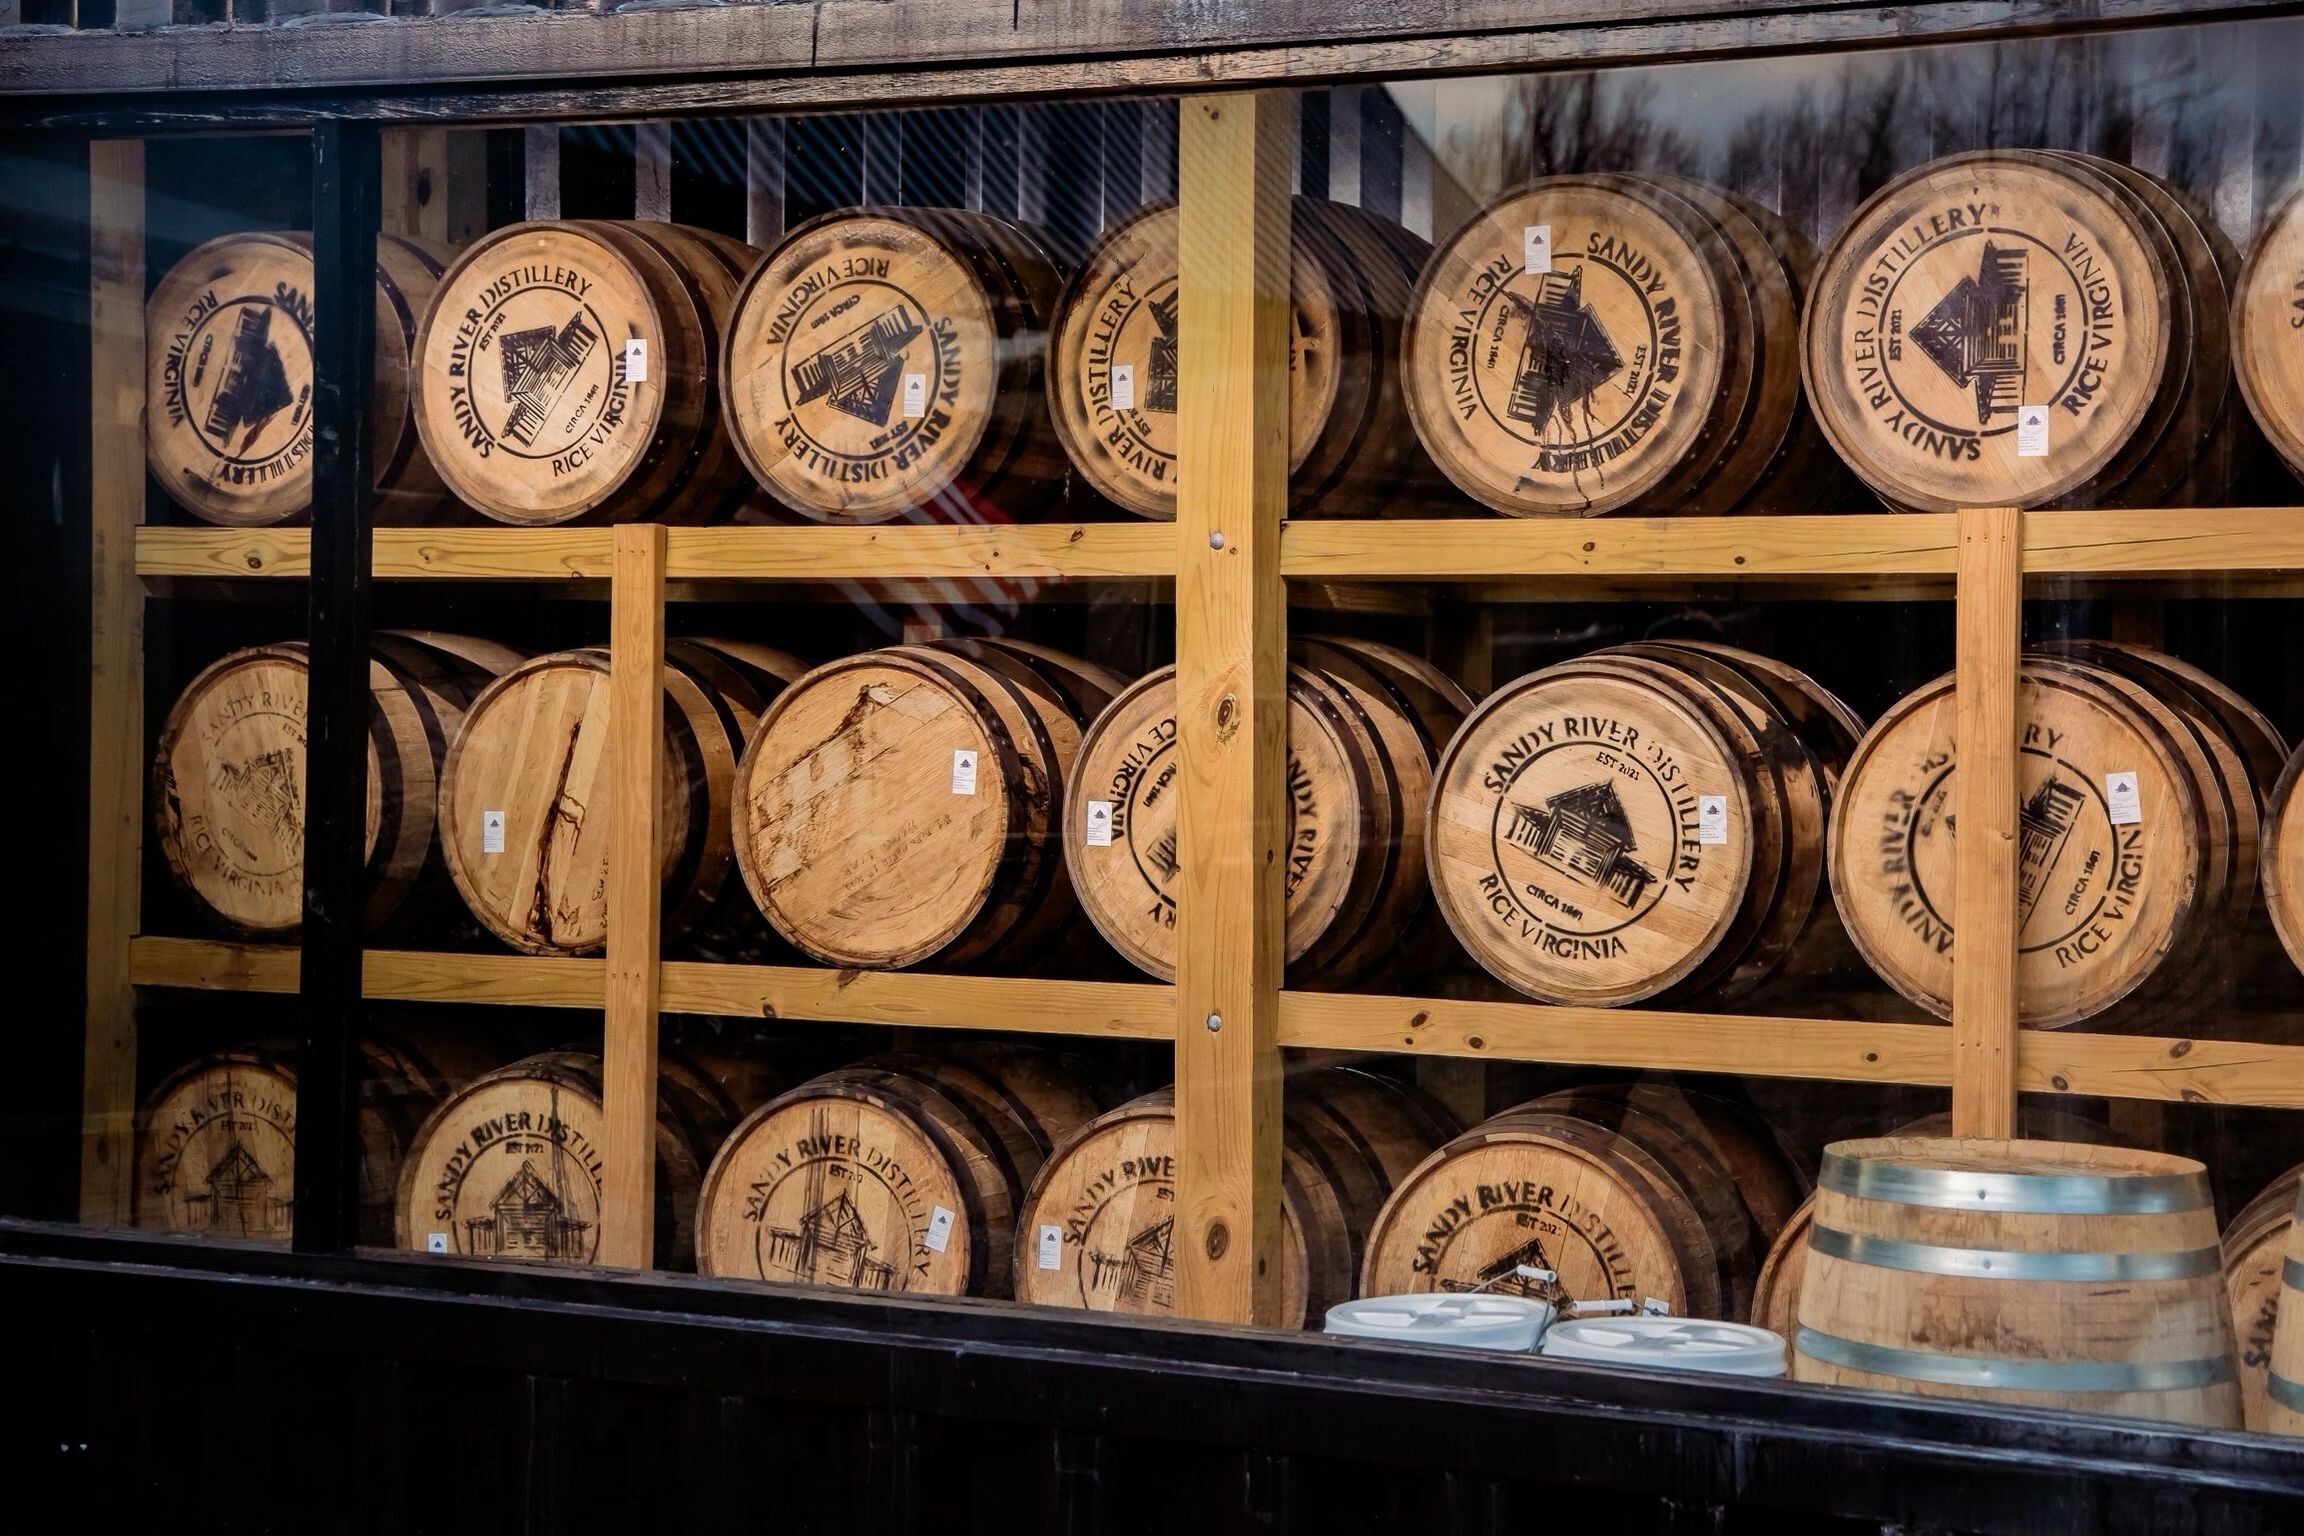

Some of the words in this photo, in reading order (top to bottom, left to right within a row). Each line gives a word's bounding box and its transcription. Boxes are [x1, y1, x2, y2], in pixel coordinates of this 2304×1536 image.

[478, 264, 593, 309] DISTILLERY
[843, 257, 890, 279] RICE
[1466, 253, 1513, 305] RICE
[1856, 202, 1987, 319] DISTILLERY
[2062, 232, 2114, 351] VIRGINIA
[180, 289, 219, 330] RICE
[767, 265, 841, 346] VIRGINIA
[1492, 304, 1511, 343] CIRCA
[1587, 231, 1665, 296] SANDY
[1654, 297, 1681, 383] RIVER
[449, 307, 483, 377] RIVER
[479, 332, 494, 352] EST
[934, 316, 960, 408] SANDY
[1088, 280, 1139, 426] DISTILLERY
[1449, 306, 1479, 421] VIRGINIA
[1633, 345, 1647, 370] EST
[1854, 329, 1893, 411] RIVER
[1888, 337, 1902, 361] EST
[2052, 322, 2066, 366] CIRCA
[164, 332, 186, 428] VIRGINIA
[2061, 356, 2109, 416] RICE
[450, 385, 495, 458] SANDY
[565, 404, 588, 434] CIRCA
[774, 417, 889, 484] DISTILLERY
[892, 409, 953, 472] RIVER
[1134, 418, 1152, 438] EST
[1884, 410, 1981, 462] SANDY
[552, 442, 594, 477] RICE
[1107, 423, 1167, 481] RIVER
[262, 690, 308, 719] RIVE
[1148, 717, 1176, 746] CE
[1484, 722, 1554, 795] SANDY
[1564, 716, 1639, 751] RIVER
[1596, 751, 1618, 769] EST
[1107, 742, 1153, 842] VIRGINIA
[1479, 873, 1520, 927] RICE
[1521, 918, 1628, 961] VIRGINIA
[1526, 884, 1560, 910] CIRCA
[1891, 880, 1954, 962] ANDY
[2055, 922, 2112, 969] RICE
[2104, 828, 2145, 921] VIRGIN
[2064, 876, 2089, 916] CIRCA
[435, 1141, 475, 1222] SANDY
[470, 1111, 531, 1147] RIVER
[537, 1113, 602, 1198] DISTILL
[743, 1148, 792, 1222] SANDY
[796, 1134, 861, 1159] RIVER
[828, 1164, 848, 1177] EST
[1063, 1168, 1115, 1245] SANDY
[1121, 1154, 1175, 1178] RIVE
[1412, 1194, 1473, 1276] SANDY
[1477, 1180, 1554, 1210] RIVER
